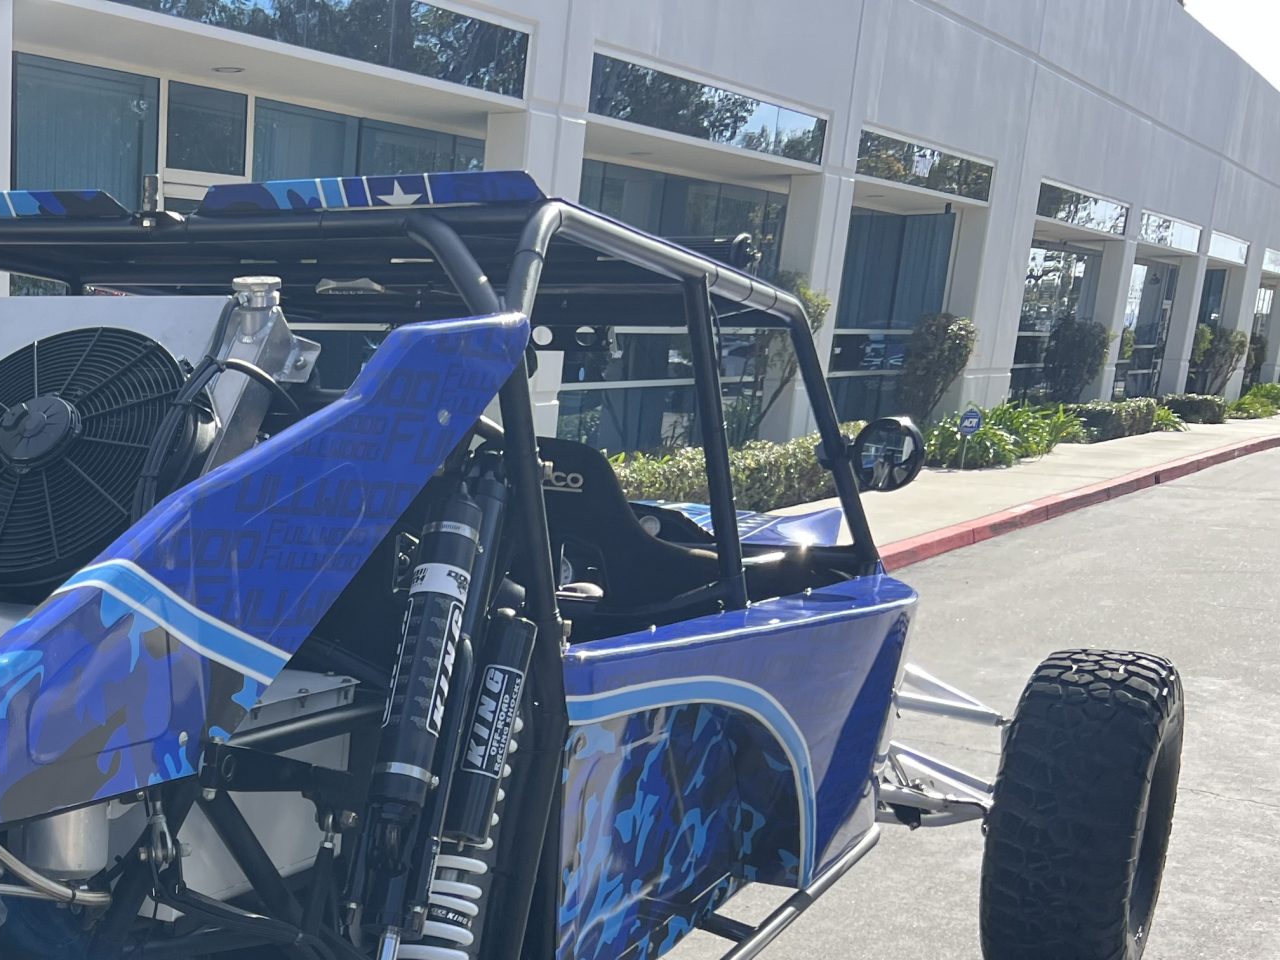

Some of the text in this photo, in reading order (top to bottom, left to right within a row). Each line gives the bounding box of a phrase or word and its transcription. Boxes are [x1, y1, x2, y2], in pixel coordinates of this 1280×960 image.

[466, 668, 504, 768] KING
[490, 694, 510, 756] OFF-ROAD
[494, 677, 521, 771] RACING SHOCKS
